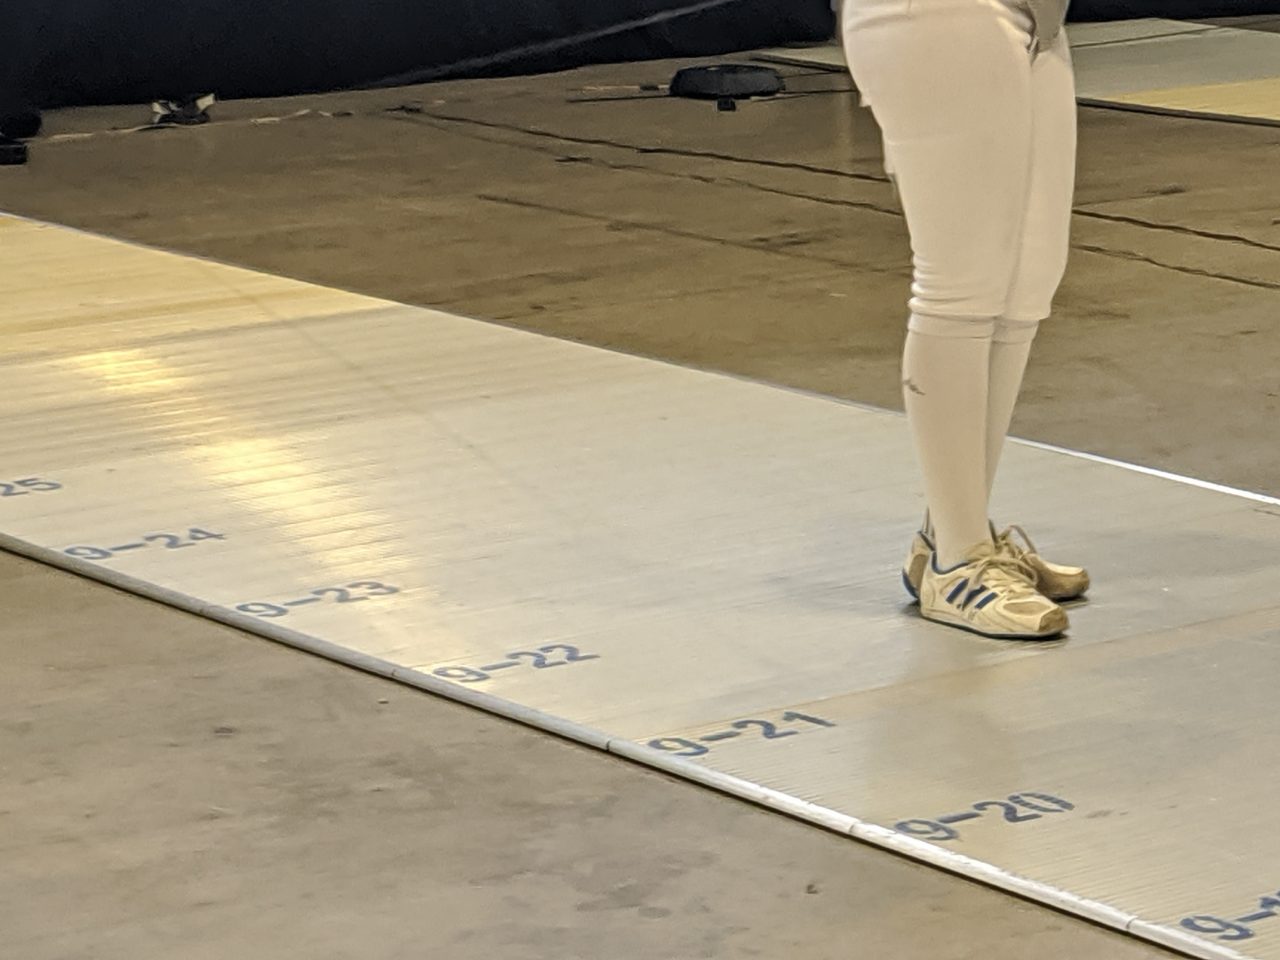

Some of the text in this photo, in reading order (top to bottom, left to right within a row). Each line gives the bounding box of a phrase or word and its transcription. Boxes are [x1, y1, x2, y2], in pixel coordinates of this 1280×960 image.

[0, 477, 62, 497] 25
[64, 528, 226, 560] 9-24
[236, 581, 400, 617] 9-23
[432, 643, 600, 683] 9-22
[647, 711, 837, 757] 9-21
[894, 791, 1076, 841] 9-20
